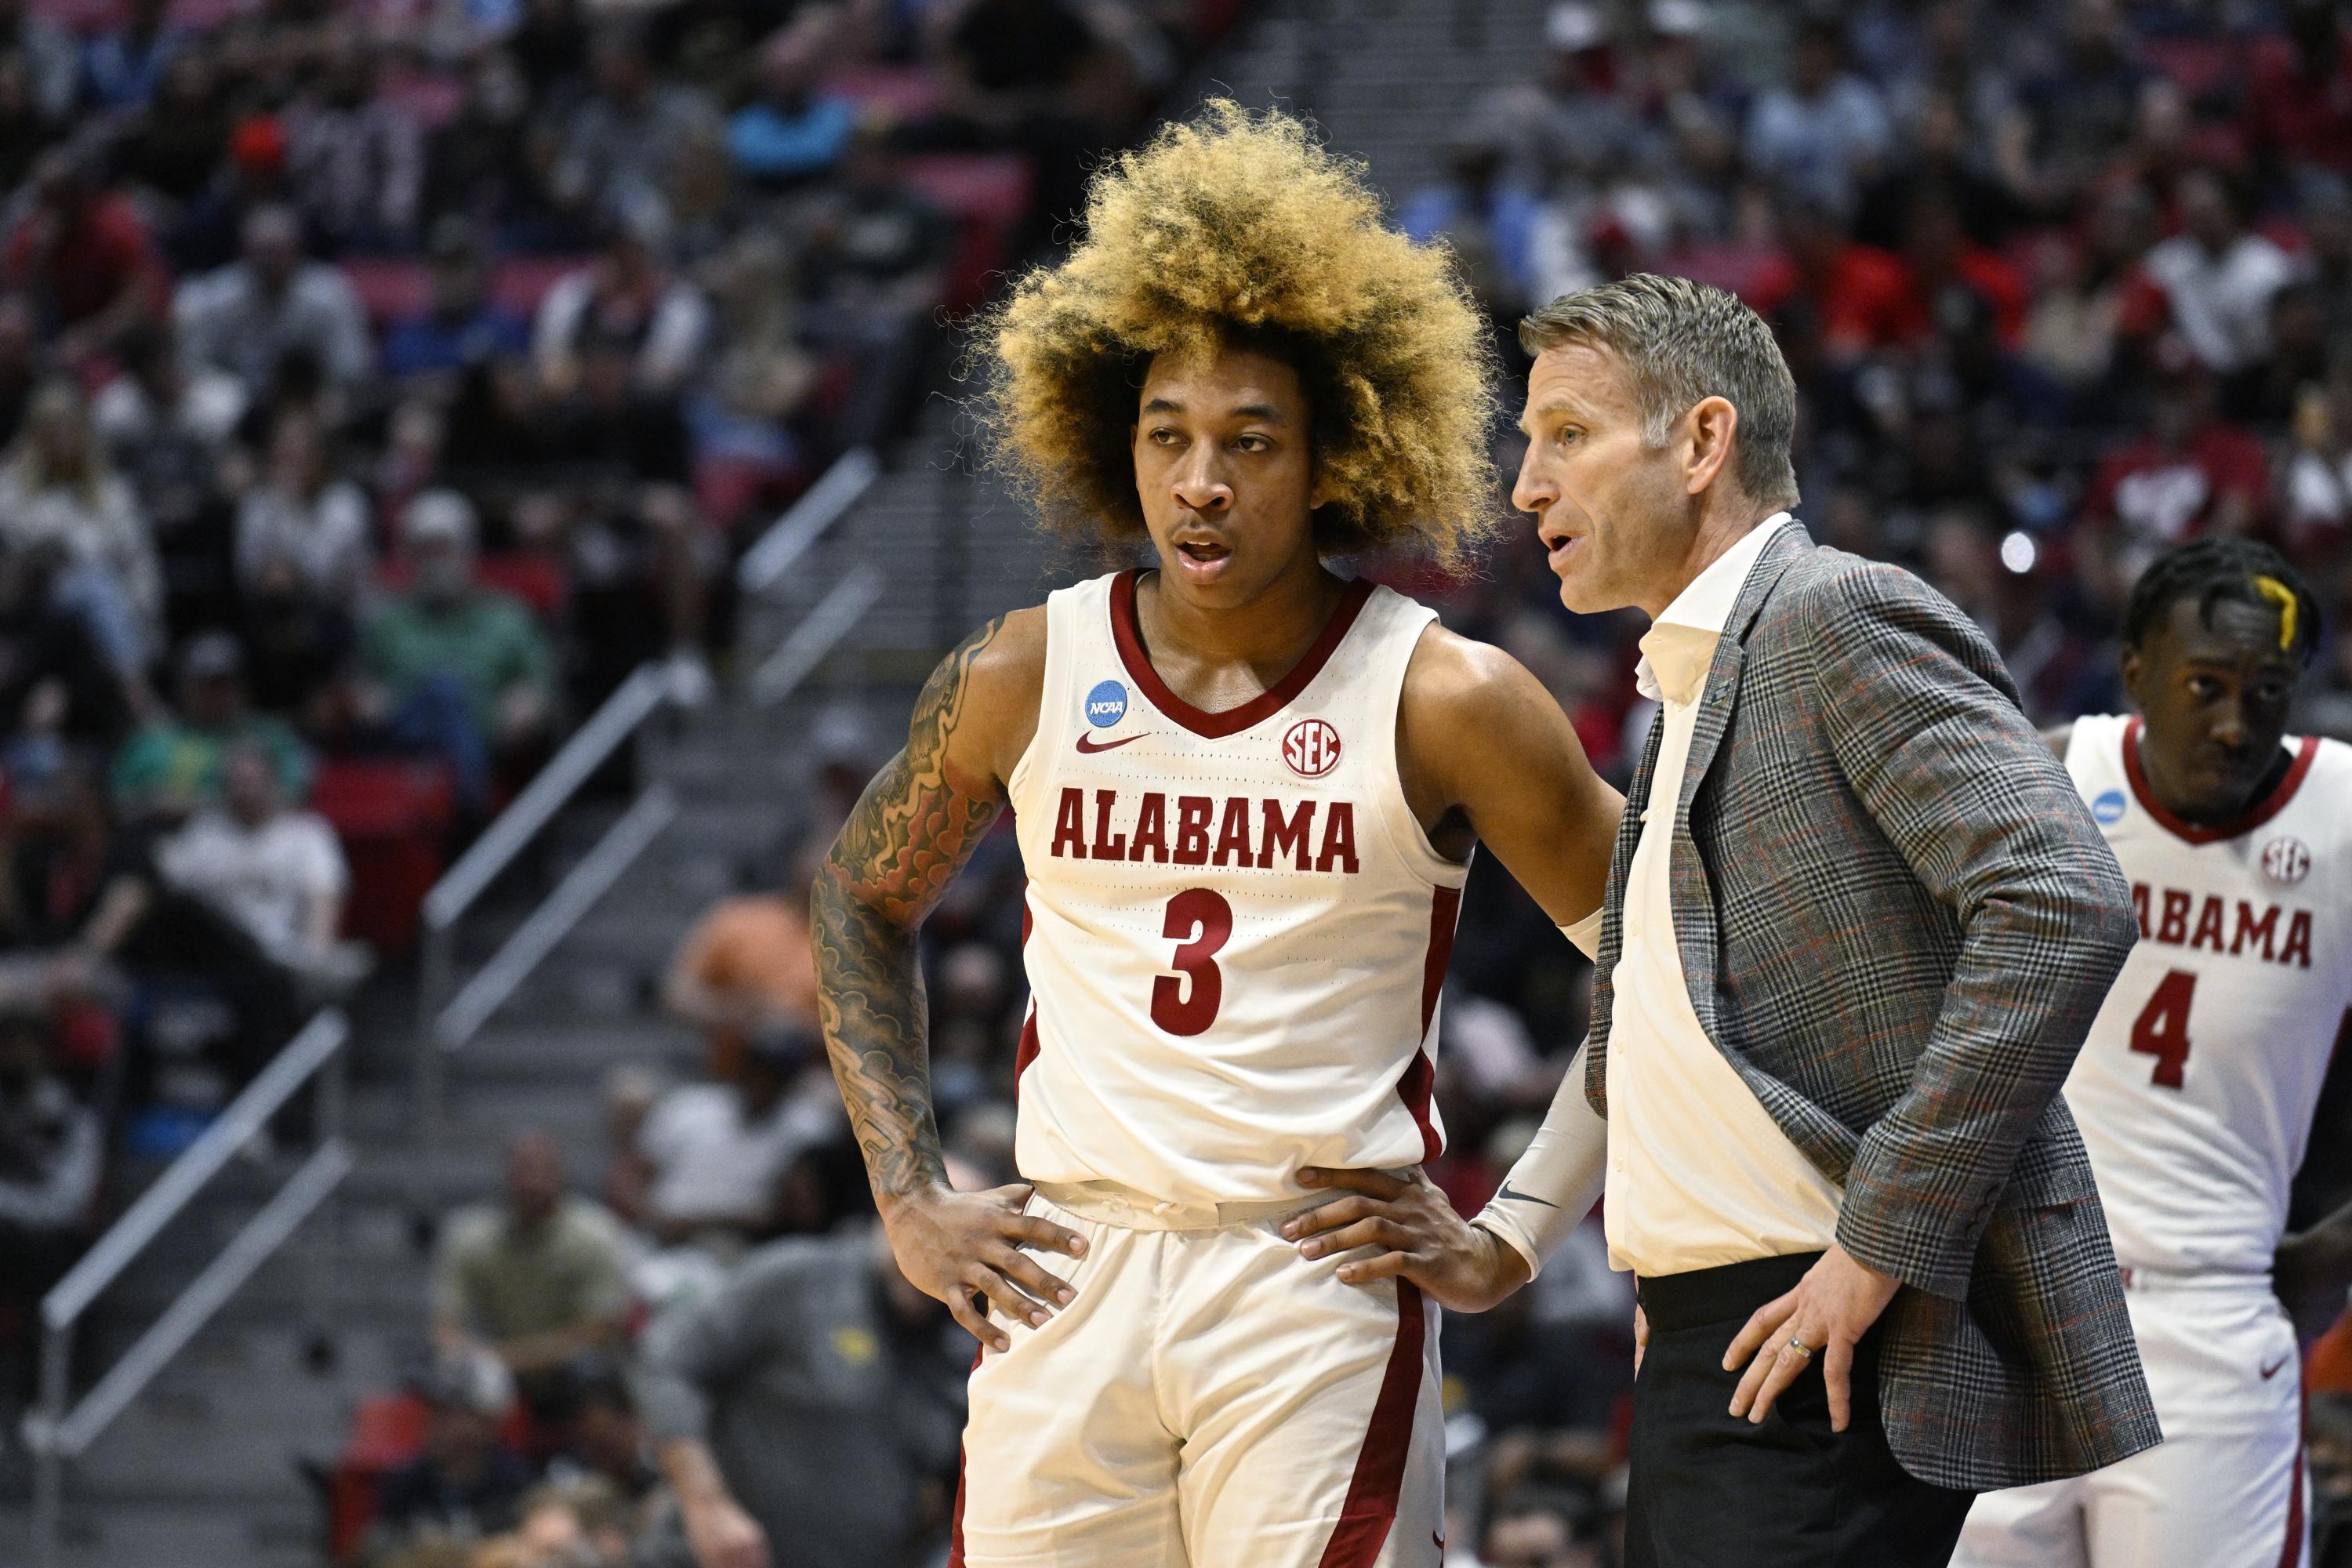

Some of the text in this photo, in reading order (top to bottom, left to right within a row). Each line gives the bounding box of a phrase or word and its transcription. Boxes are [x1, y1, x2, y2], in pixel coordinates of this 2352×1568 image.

[1090, 701, 1123, 714] NCAA
[1286, 722, 1337, 773] SEC
[1051, 787, 1359, 873] ALABAMA
[1150, 887, 1233, 1036] 3
[2129, 968, 2198, 1089] 4
